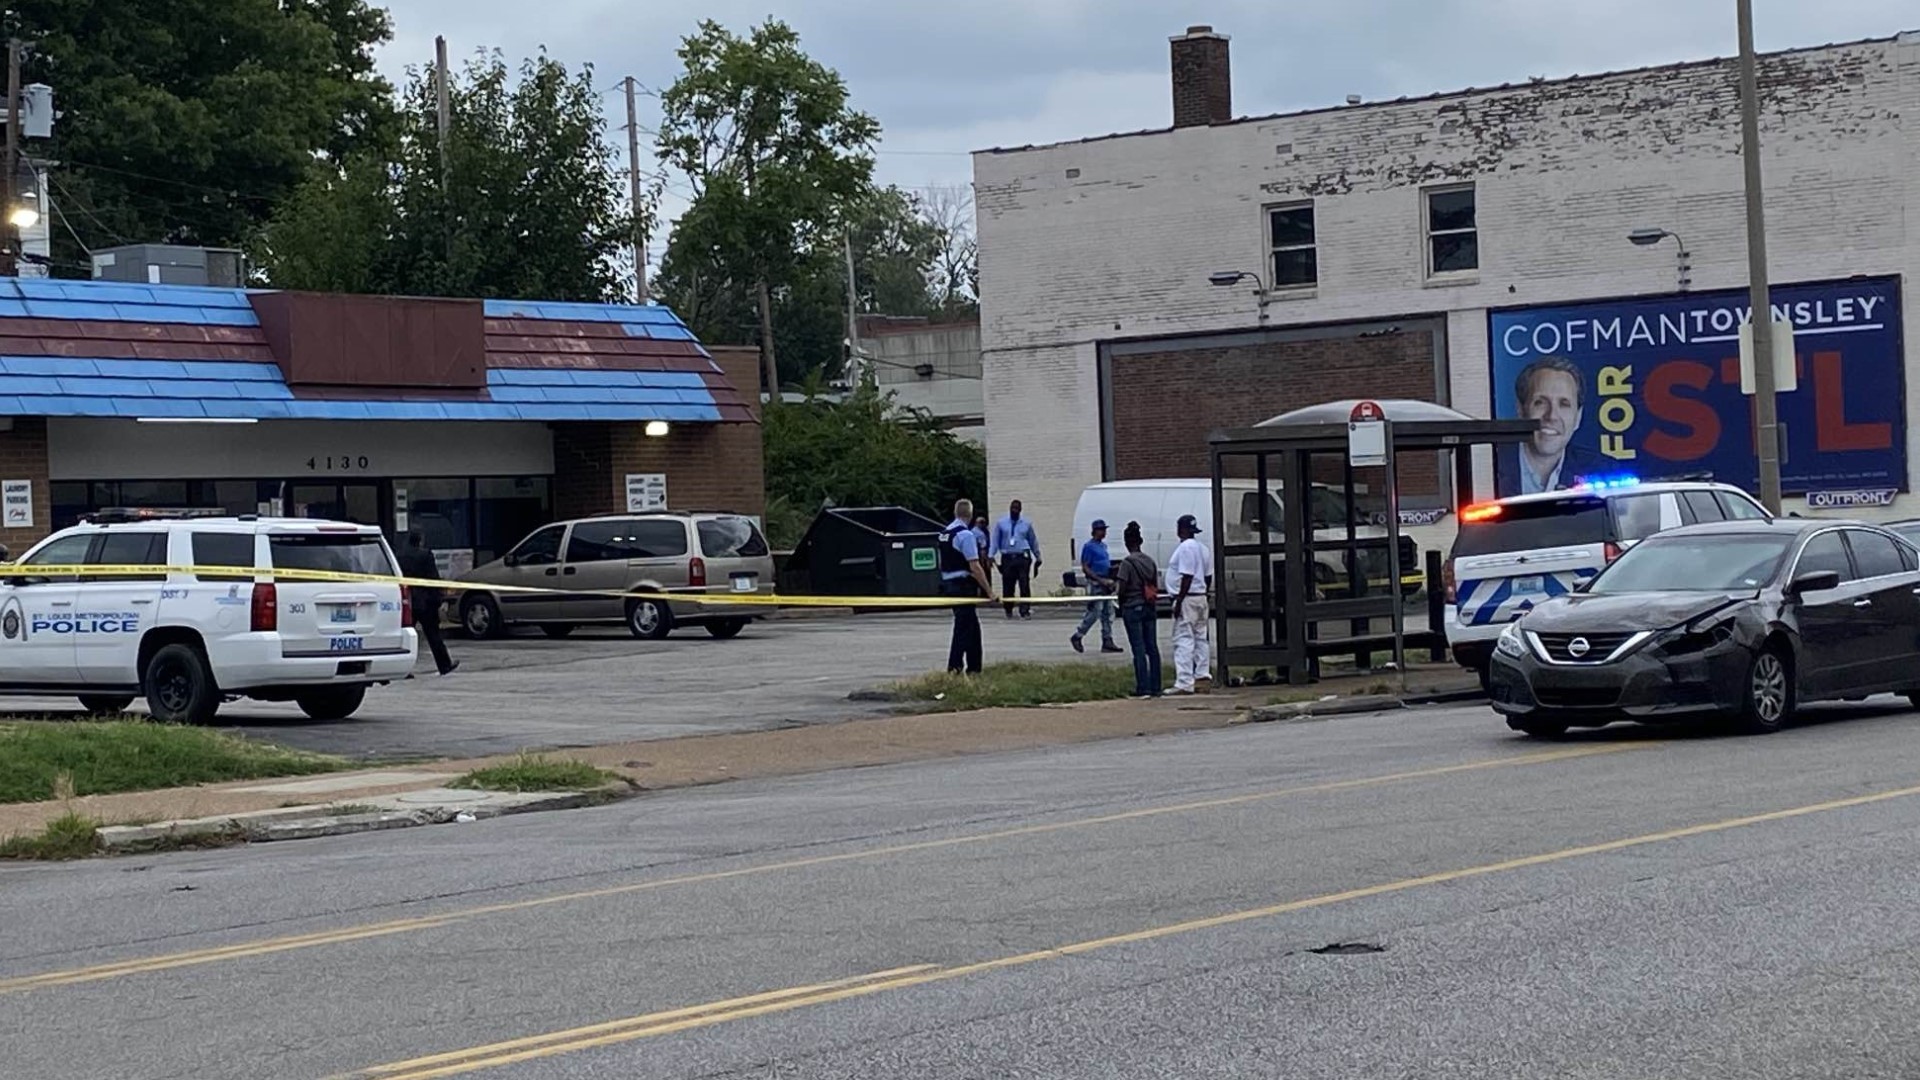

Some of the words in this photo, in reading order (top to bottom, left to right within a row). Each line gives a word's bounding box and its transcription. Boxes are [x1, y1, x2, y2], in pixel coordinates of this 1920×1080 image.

[1503, 312, 1686, 356] COFMAN
[1598, 364, 1636, 460] FOR
[1642, 351, 1893, 461] SL
[306, 456, 368, 470] 4130
[1816, 492, 1887, 505] OUTFRONT
[1377, 511, 1437, 524] OFRONT
[289, 604, 305, 613] 303
[32, 620, 139, 633] POLICE
[331, 637, 363, 650] POLICE
